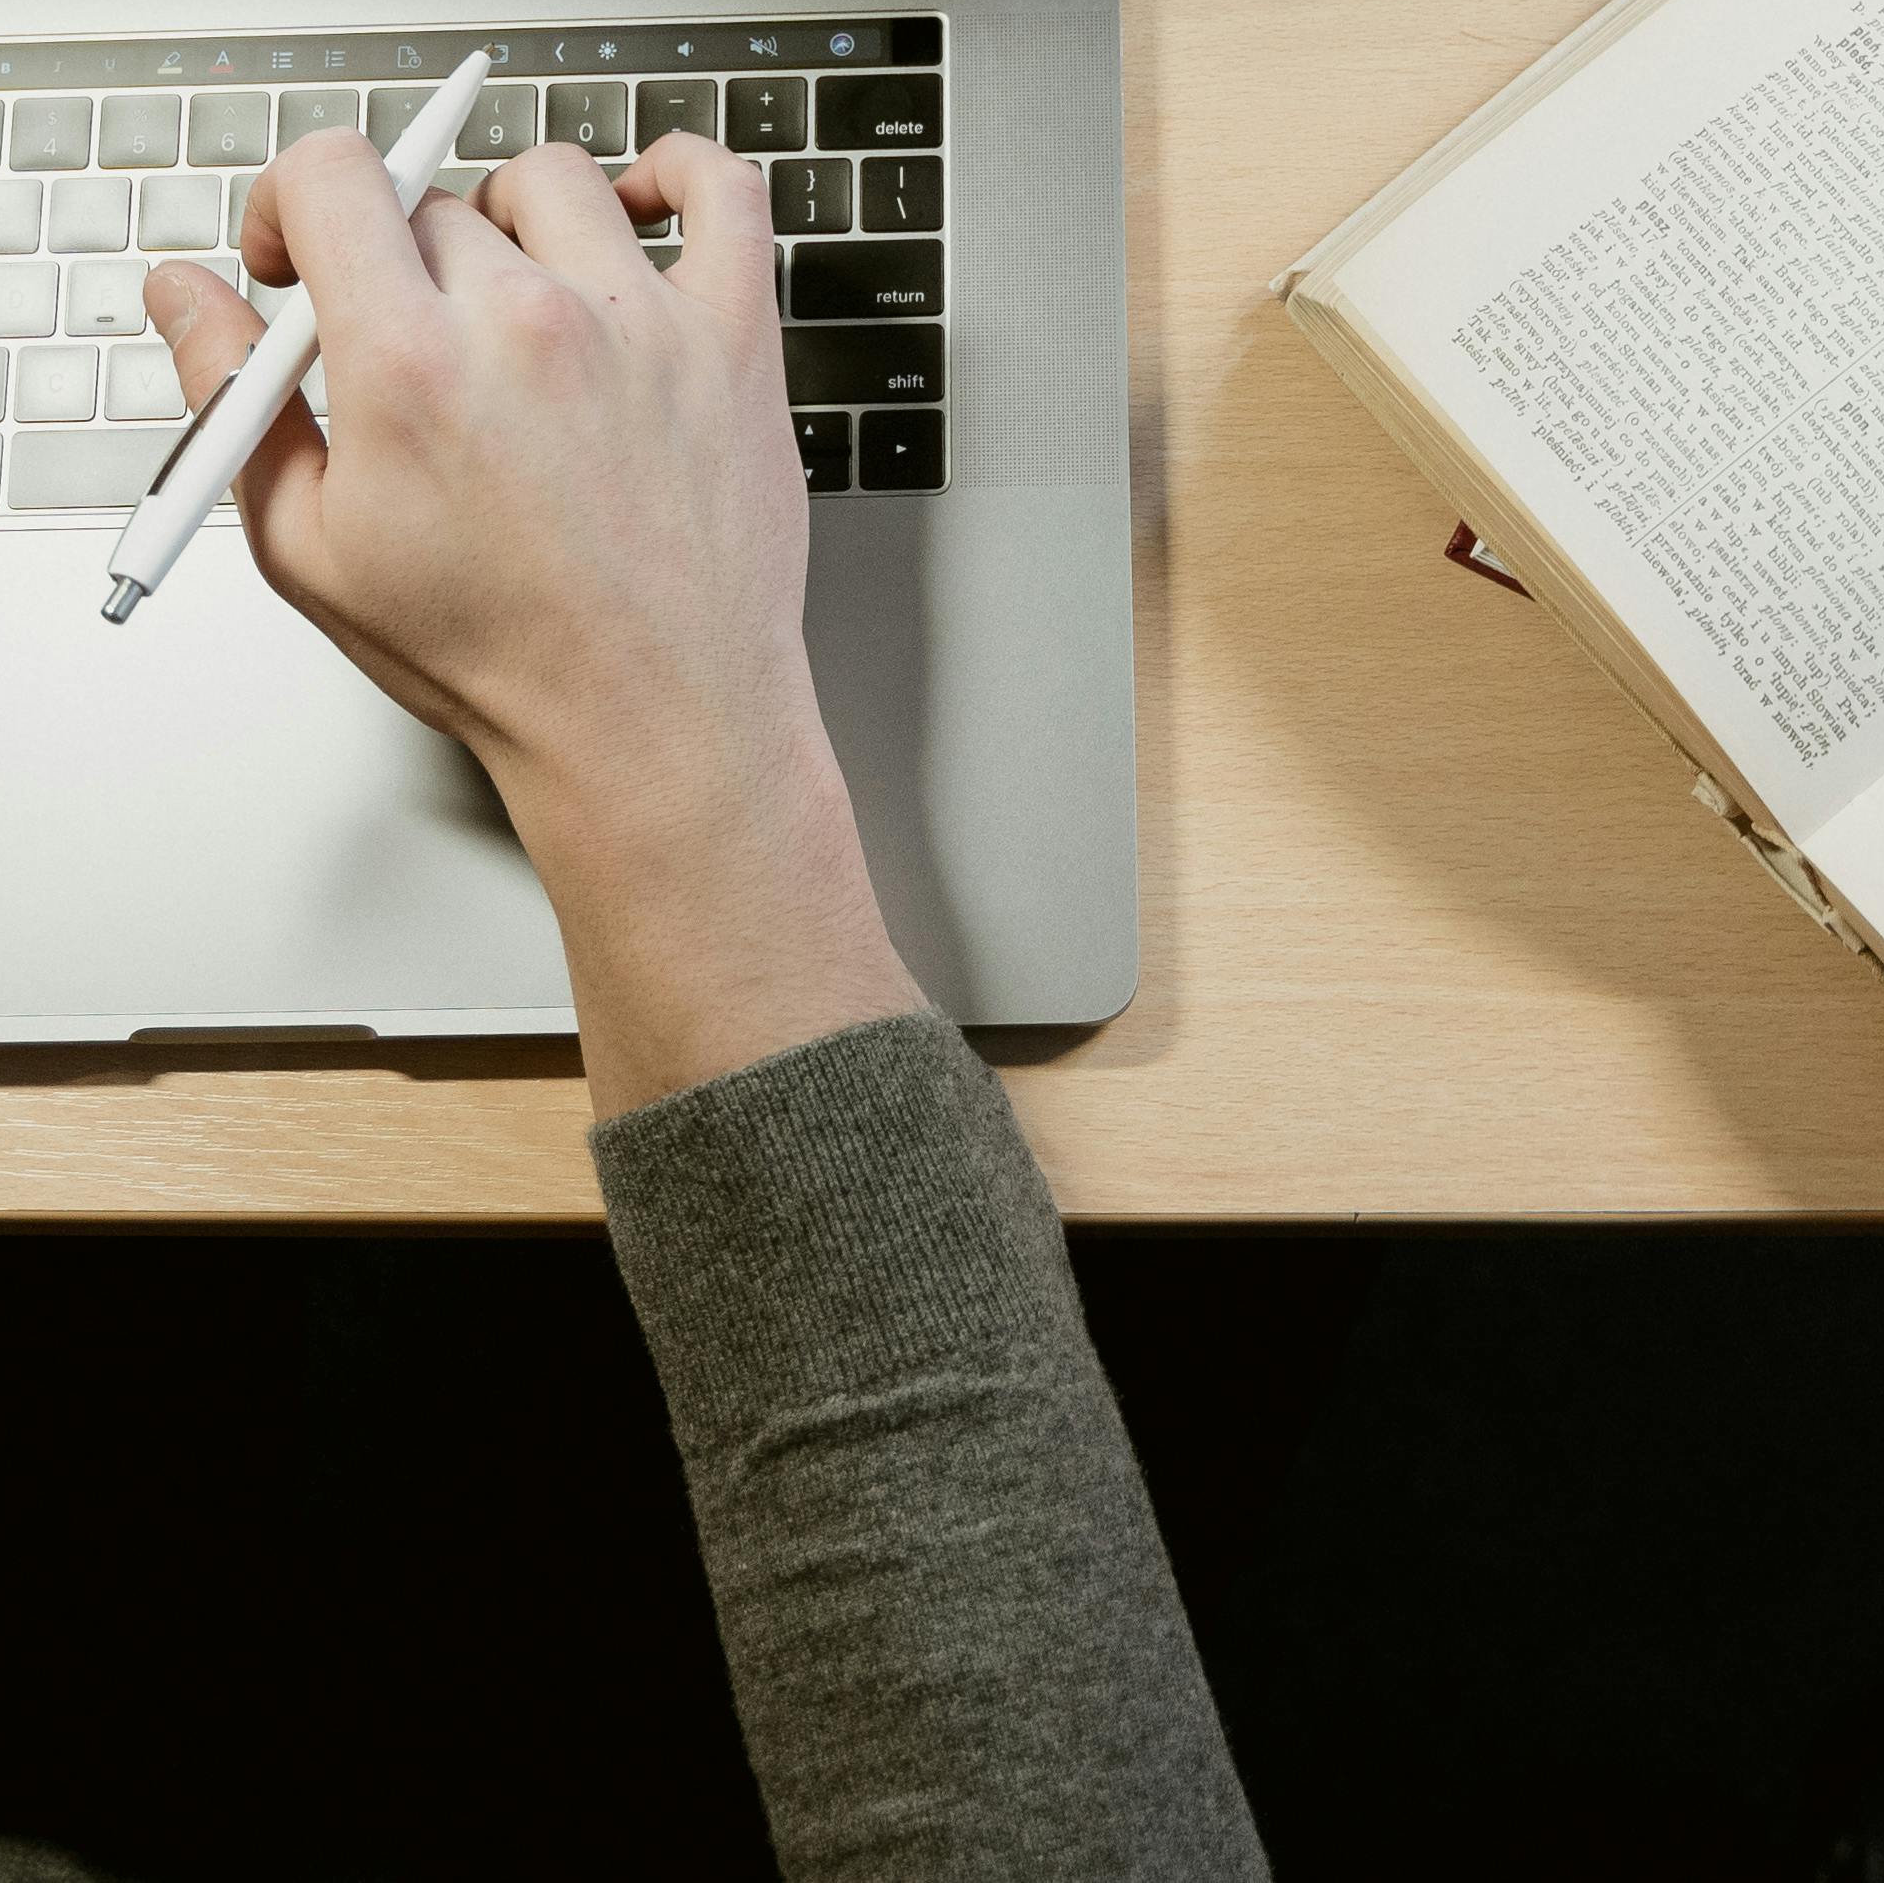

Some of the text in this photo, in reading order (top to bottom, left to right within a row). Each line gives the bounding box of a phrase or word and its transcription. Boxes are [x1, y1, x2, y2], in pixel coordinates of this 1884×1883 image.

[488, 125, 504, 145] 9
[875, 120, 924, 136] delete
[43, 137, 57, 156] 4
[132, 134, 147, 155] 5
[221, 132, 236, 152] 6
[875, 290, 926, 305] return
[888, 373, 925, 391] shift
